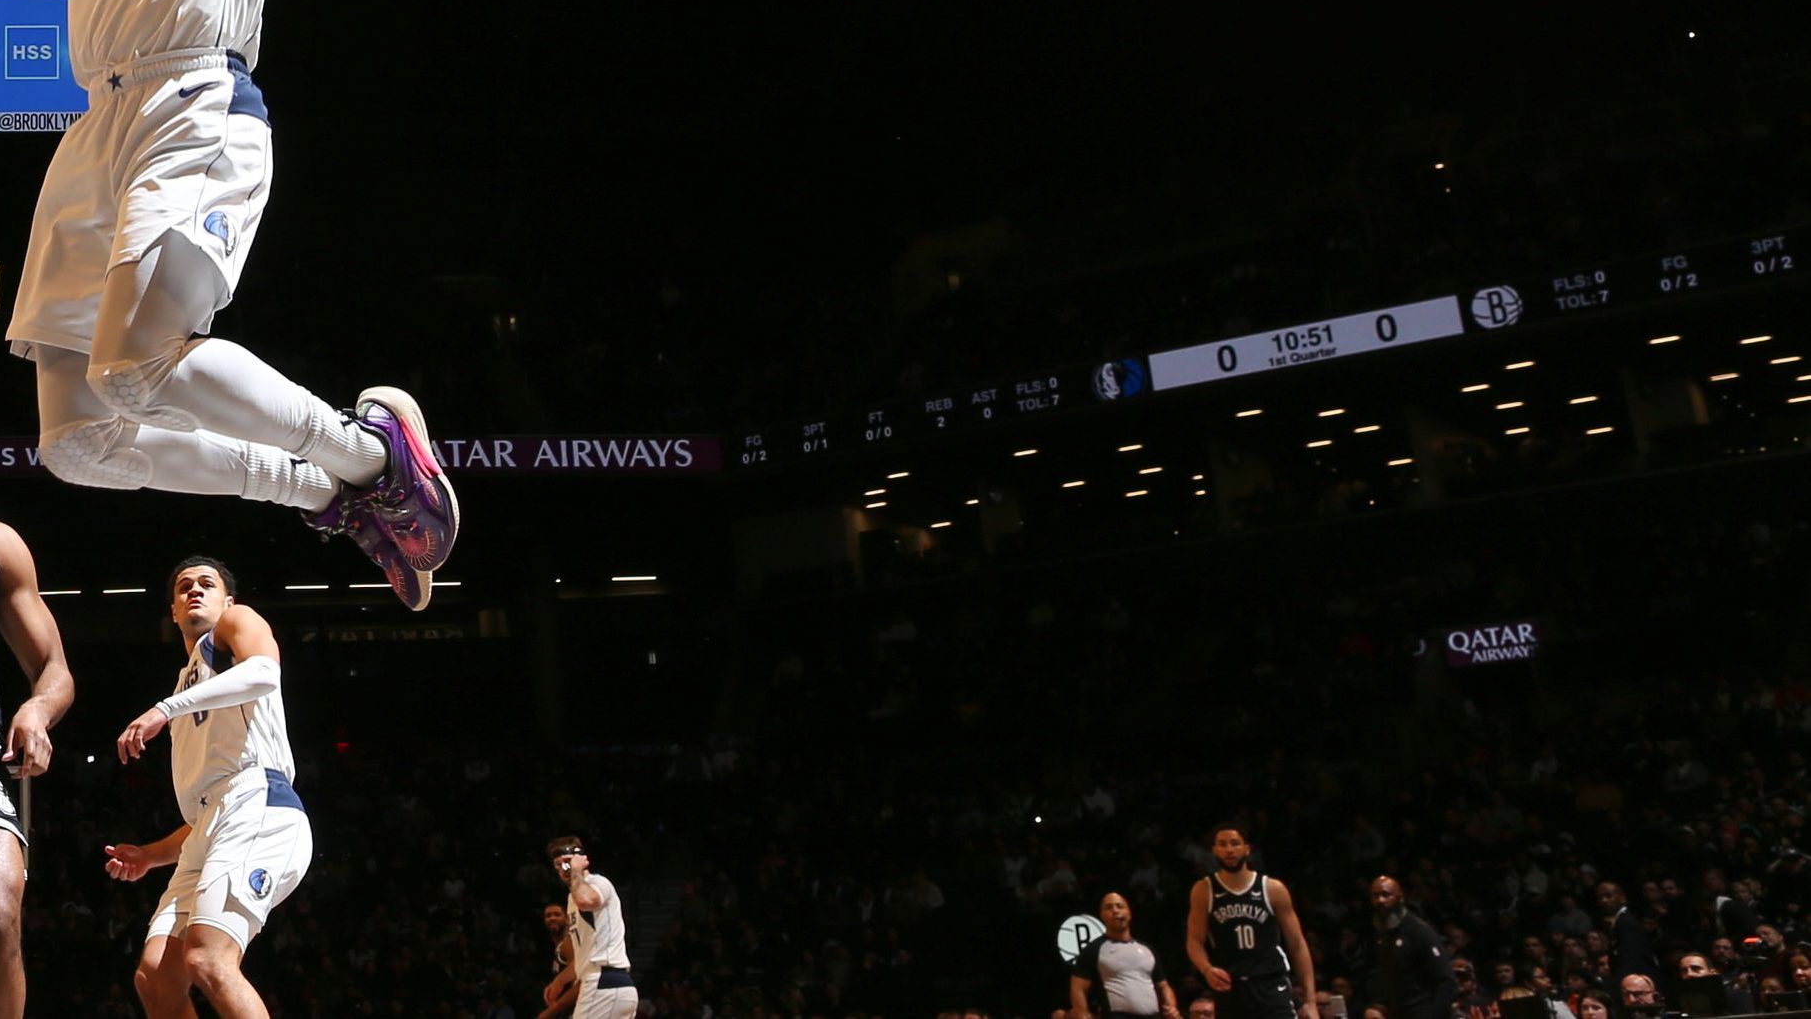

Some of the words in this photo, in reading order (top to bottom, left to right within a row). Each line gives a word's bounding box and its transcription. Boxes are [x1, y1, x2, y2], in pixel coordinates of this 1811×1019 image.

[12, 44, 52, 60] HSS
[1750, 236, 1786, 255] 3PT
[1660, 254, 1689, 272] FG
[1753, 259, 1766, 275] 0
[1780, 255, 1793, 270] 2
[1553, 275, 1591, 292] FLS:
[1594, 270, 1606, 284] 0
[1659, 277, 1672, 293] 0
[1686, 272, 1699, 288] 2
[1554, 292, 1598, 311] TOL:
[1599, 289, 1611, 304] 7
[1376, 314, 1397, 342] 0
[1272, 324, 1333, 353] 10:51
[1217, 345, 1237, 372] 0
[1268, 354, 1287, 367] 1st
[1290, 347, 1337, 363] Quarter
[1015, 380, 1046, 395] FLS:
[1048, 377, 1058, 389] 0
[925, 397, 953, 413] REB
[972, 389, 997, 405] AST
[1016, 396, 1050, 412] TOL:
[1051, 393, 1060, 406] 7
[868, 410, 884, 425] FT
[937, 416, 946, 428] 2
[983, 406, 992, 419] 0
[802, 421, 826, 437] 3PT
[865, 429, 873, 441] 0
[884, 426, 892, 438] 0
[744, 434, 763, 448] FG
[802, 441, 811, 452] 0
[821, 438, 828, 450] 1
[533, 438, 692, 468] AIRWAYS
[742, 453, 750, 464] 0
[759, 449, 767, 461] 2
[1447, 623, 1537, 654] QATAR
[1472, 645, 1533, 664] AIRWAY
[1213, 903, 1269, 924] BROOKLYN
[1234, 924, 1255, 950] 10
